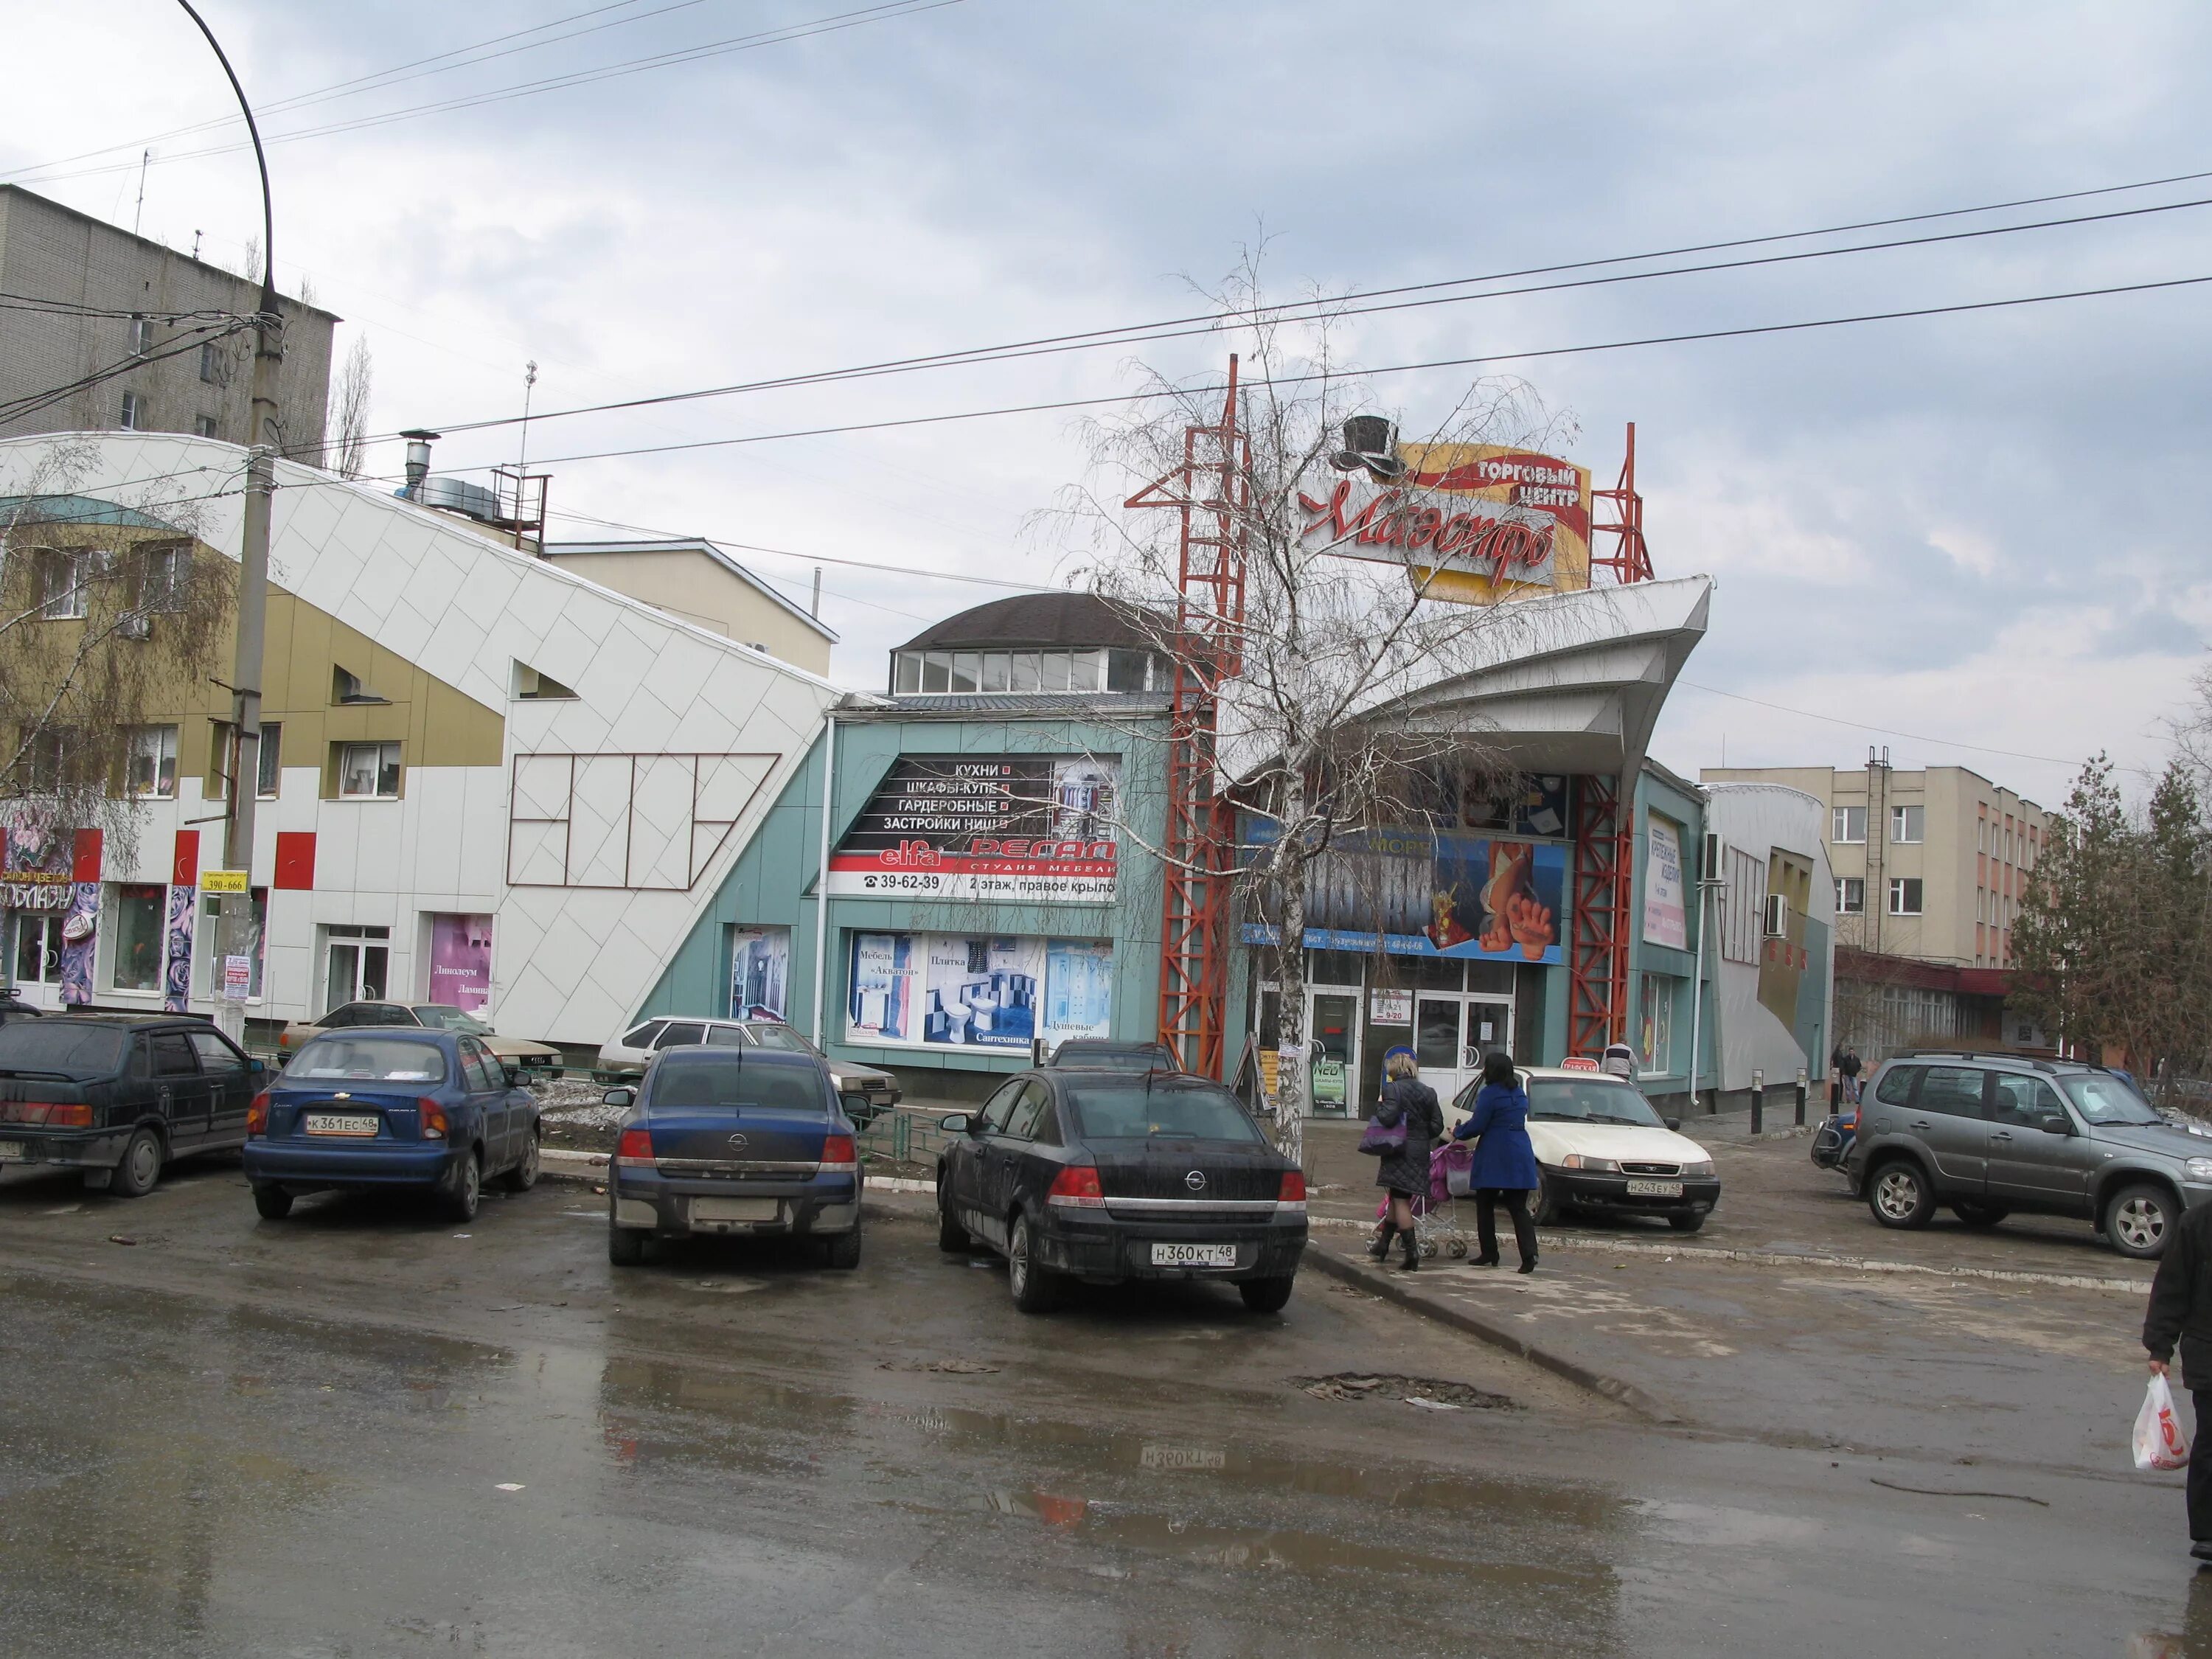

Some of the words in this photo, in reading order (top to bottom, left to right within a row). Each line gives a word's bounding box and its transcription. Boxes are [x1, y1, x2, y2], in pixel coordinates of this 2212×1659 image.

[1478, 461, 1576, 487] ТОРГОВЫЙ
[1520, 486, 1579, 507] ЦЕНТР
[956, 765, 998, 776] КУХНИ
[907, 782, 998, 794] ШКАФЫ-КУПЕ
[898, 799, 997, 814] ГАРДЕРОБНЫЕ
[884, 815, 961, 830] ЗАСТРОЙКИ
[880, 840, 941, 866] elfa
[970, 863, 1036, 872] СТУДИЯ
[209, 880, 242, 890] 390-666
[880, 875, 939, 889] 39-62-39
[970, 877, 977, 888] 2
[1019, 882, 1067, 894] правое
[1071, 883, 1115, 894] крыло
[0, 883, 76, 908] ОБЛАЗН
[860, 950, 892, 960] Мебель
[931, 956, 965, 966] Плитка
[434, 964, 477, 978] Линолеум
[871, 965, 919, 976] «Акватон»
[1048, 1020, 1094, 1032] Душевые
[976, 1032, 1030, 1045] Сантехника
